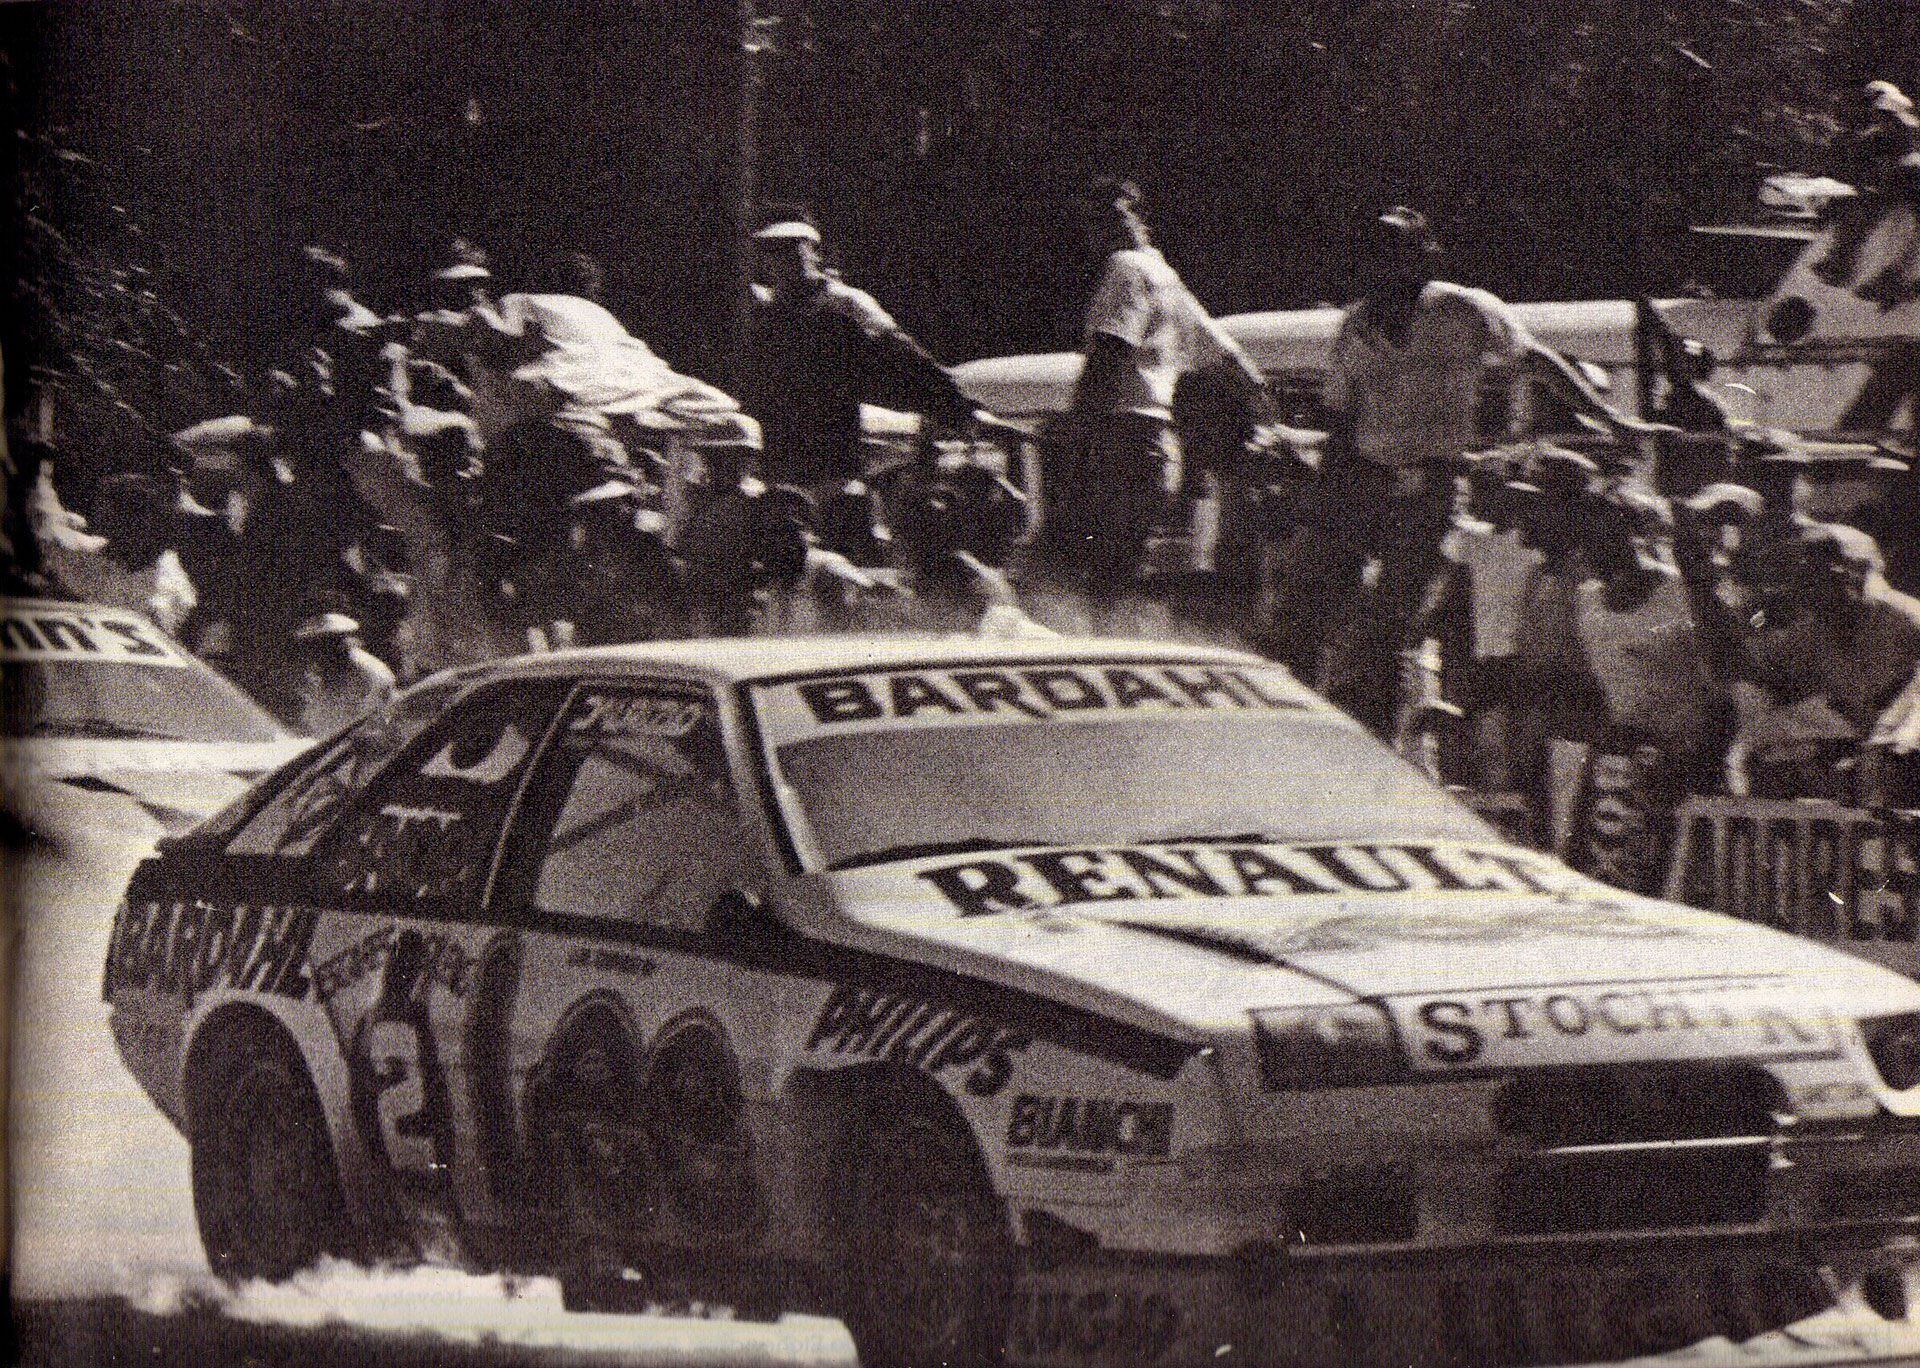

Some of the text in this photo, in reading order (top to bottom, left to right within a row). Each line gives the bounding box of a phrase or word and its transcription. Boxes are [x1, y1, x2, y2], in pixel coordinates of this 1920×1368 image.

[798, 668, 1309, 725] BARDAHL
[917, 844, 1562, 918] RENAULT
[804, 986, 1031, 1097] PHILIPS
